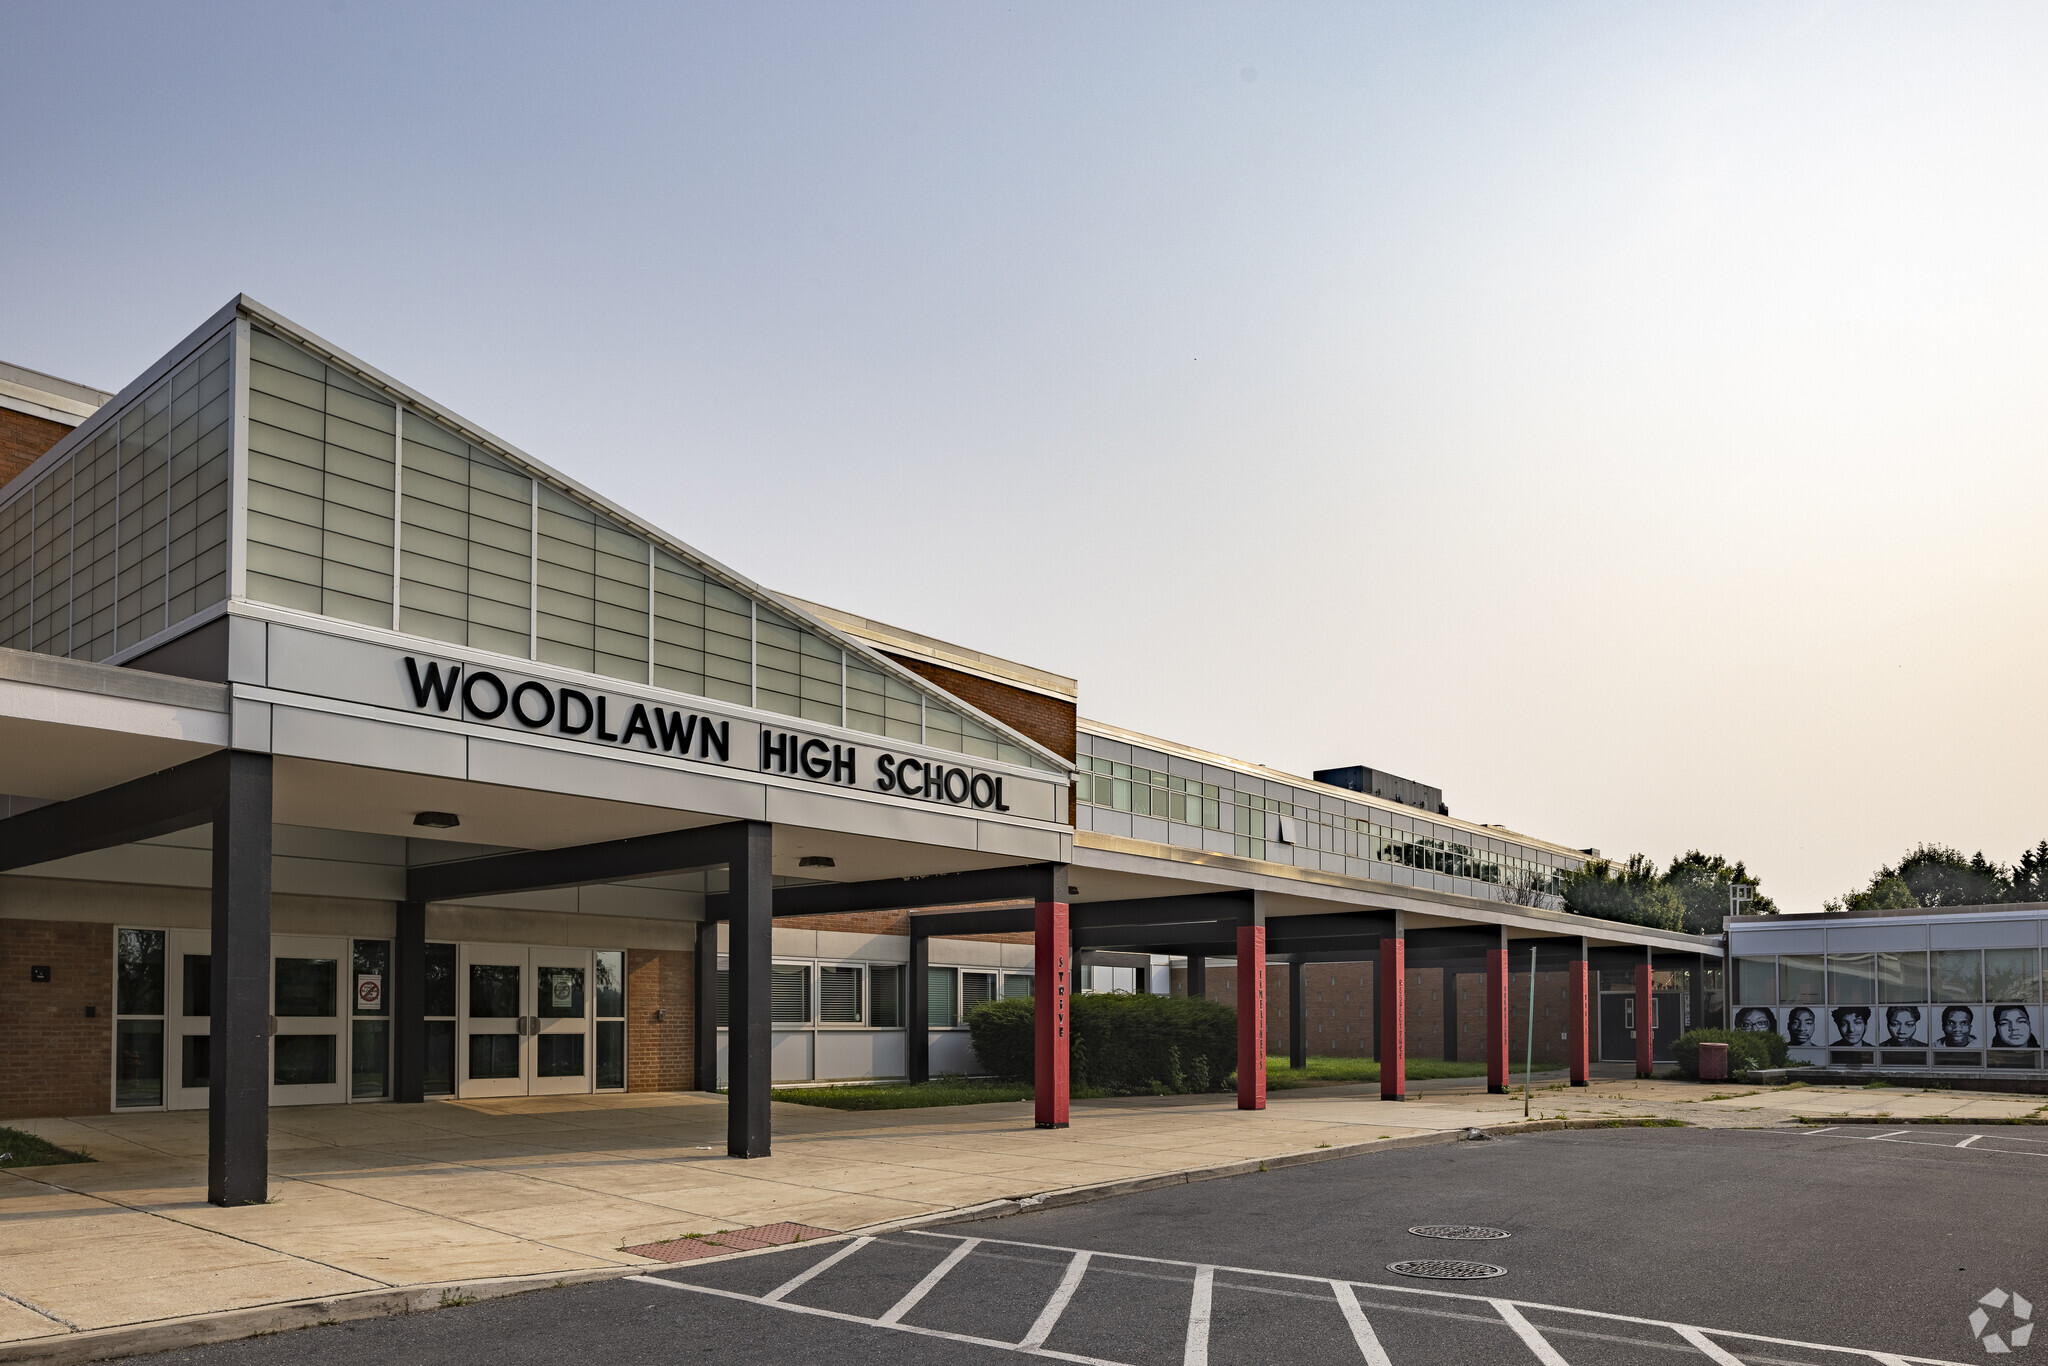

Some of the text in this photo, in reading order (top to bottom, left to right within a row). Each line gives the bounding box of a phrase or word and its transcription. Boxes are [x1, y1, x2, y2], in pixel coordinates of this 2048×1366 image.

[405, 656, 1010, 811] WOODLAWN HIGH SCHOOL
